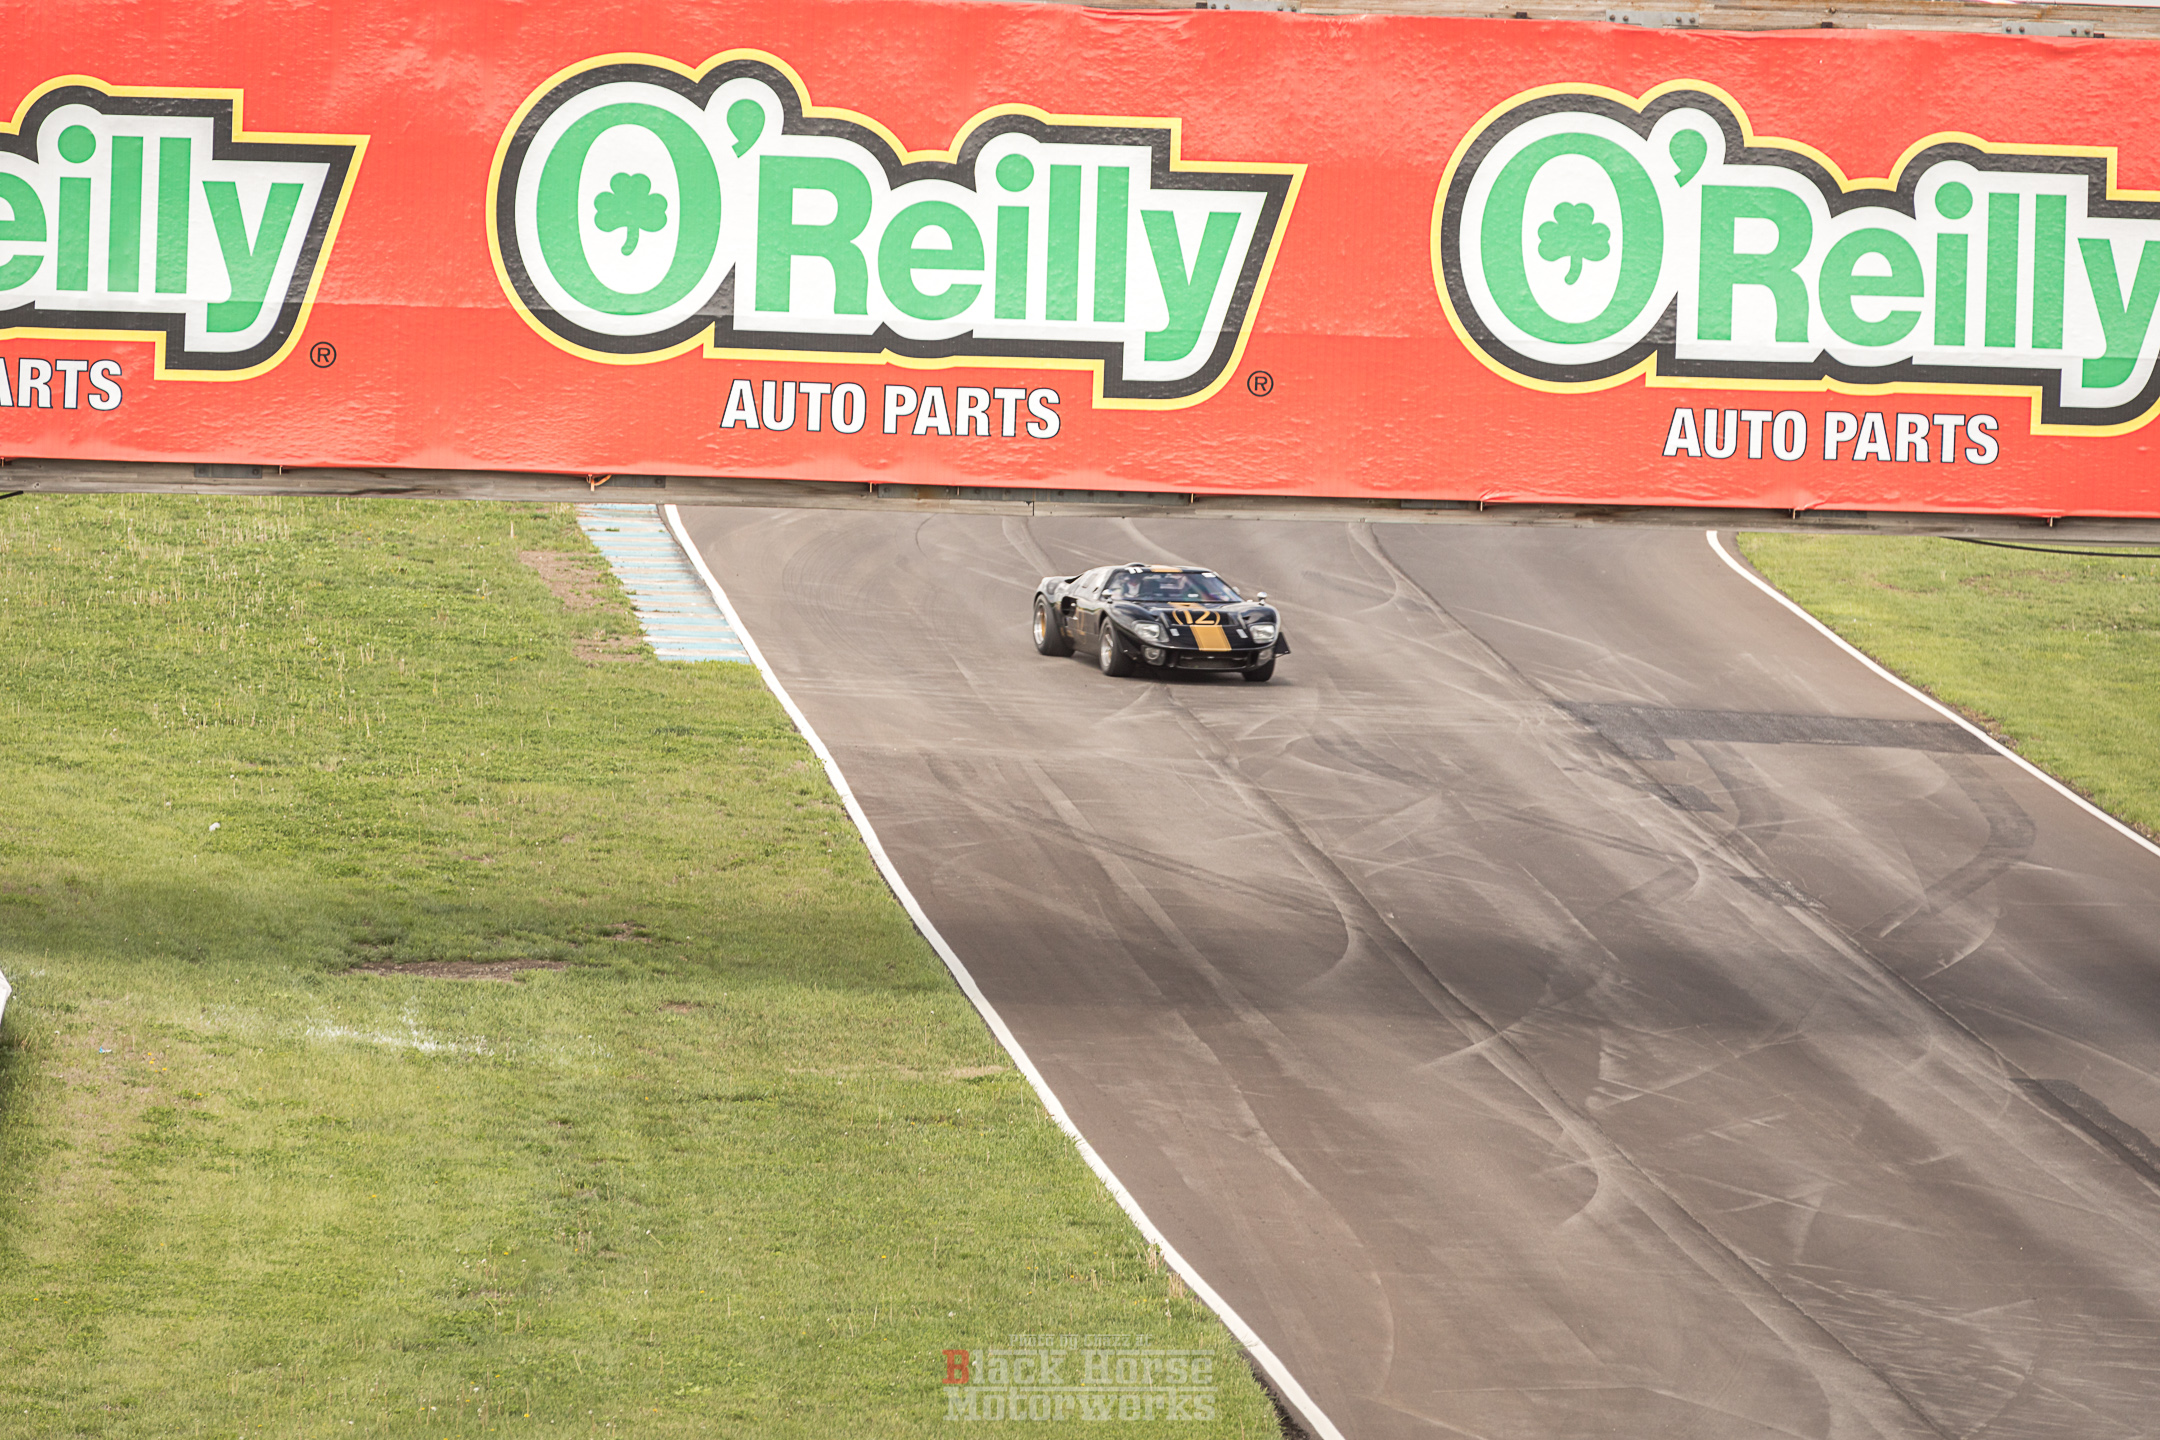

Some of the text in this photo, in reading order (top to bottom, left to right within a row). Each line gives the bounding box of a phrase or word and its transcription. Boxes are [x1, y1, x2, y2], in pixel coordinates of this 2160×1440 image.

[536, 97, 1242, 362] O'Reilly
[1480, 128, 2160, 389] O'Reilly
[719, 379, 1063, 440] AUTO PARTS
[1661, 406, 2001, 466] AUTO PARTS
